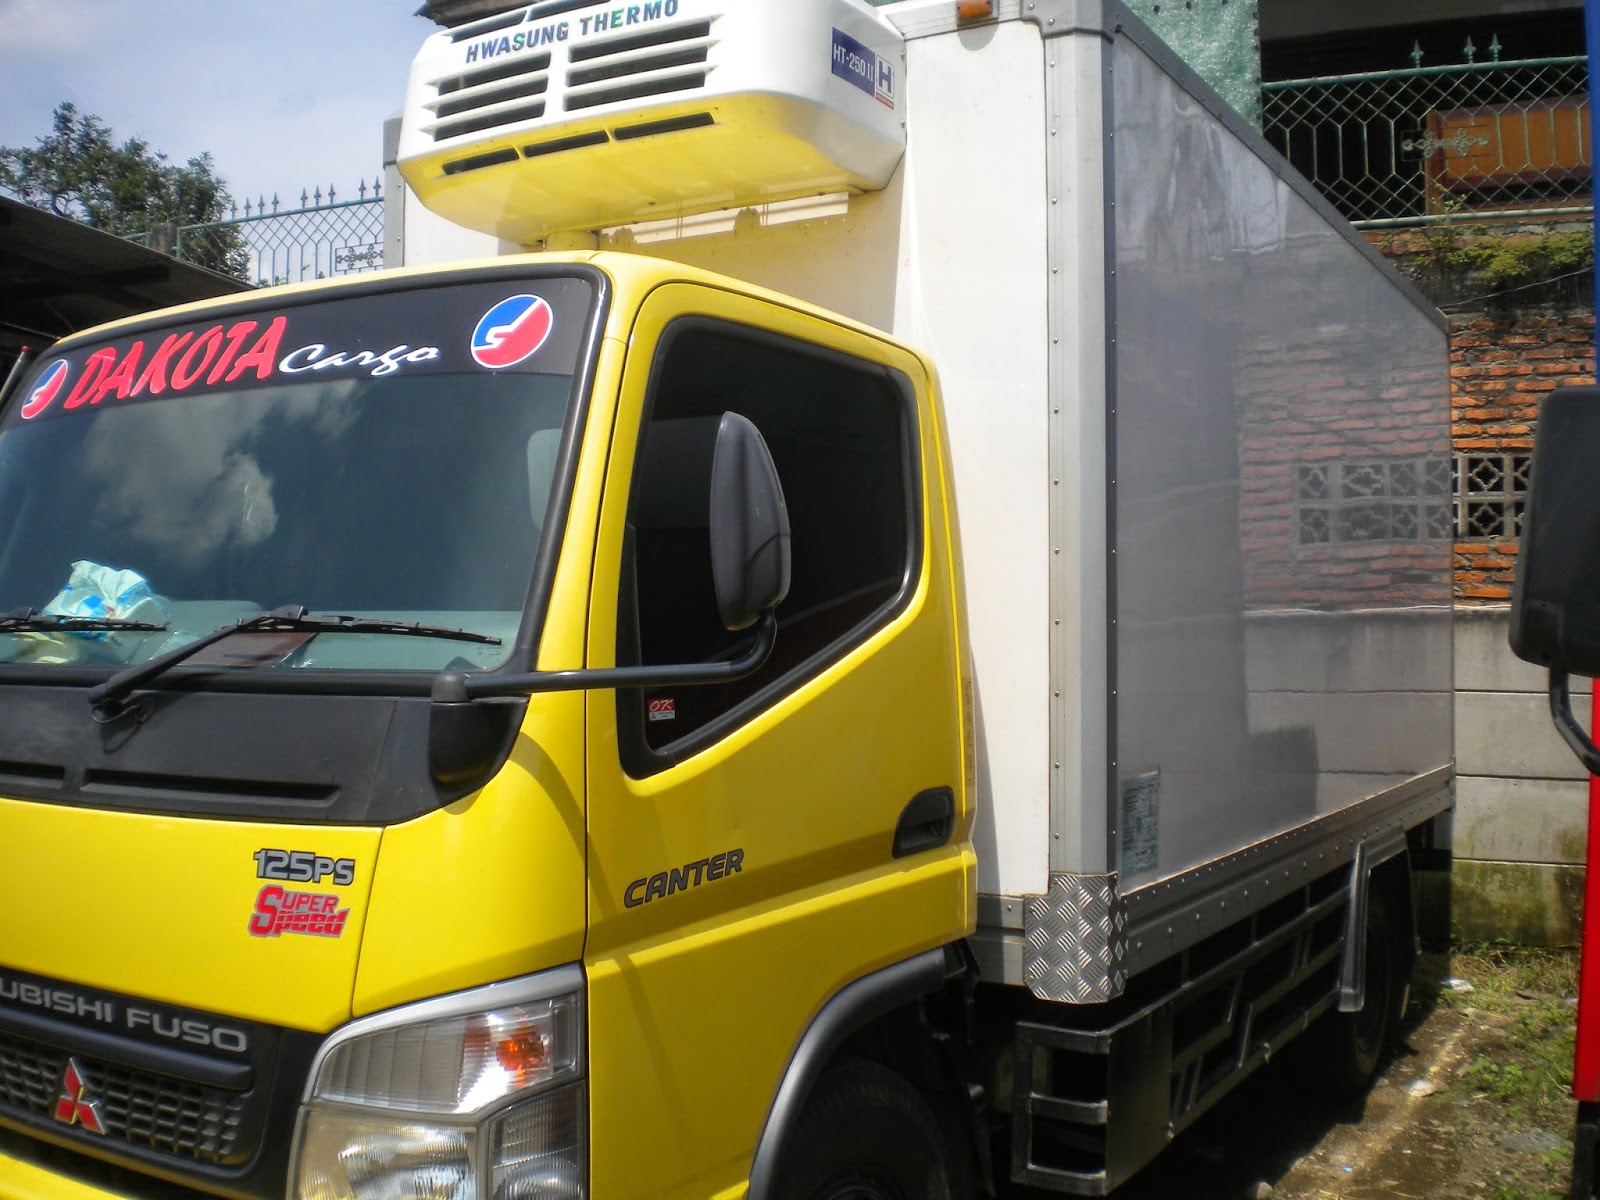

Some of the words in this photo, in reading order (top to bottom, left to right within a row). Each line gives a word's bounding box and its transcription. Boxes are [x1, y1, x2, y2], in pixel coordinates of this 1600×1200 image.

[465, 21, 570, 64] HWASUNG
[579, 0, 679, 36] THERMO
[833, 43, 866, 76] HT-250
[63, 316, 287, 410] DAKOTA
[278, 343, 440, 378] Cargo
[649, 699, 674, 712] OK
[253, 848, 356, 886] 125PS
[624, 848, 744, 908] CANTER
[0, 977, 112, 1024] UBISHI
[126, 1007, 248, 1052] FUSO
